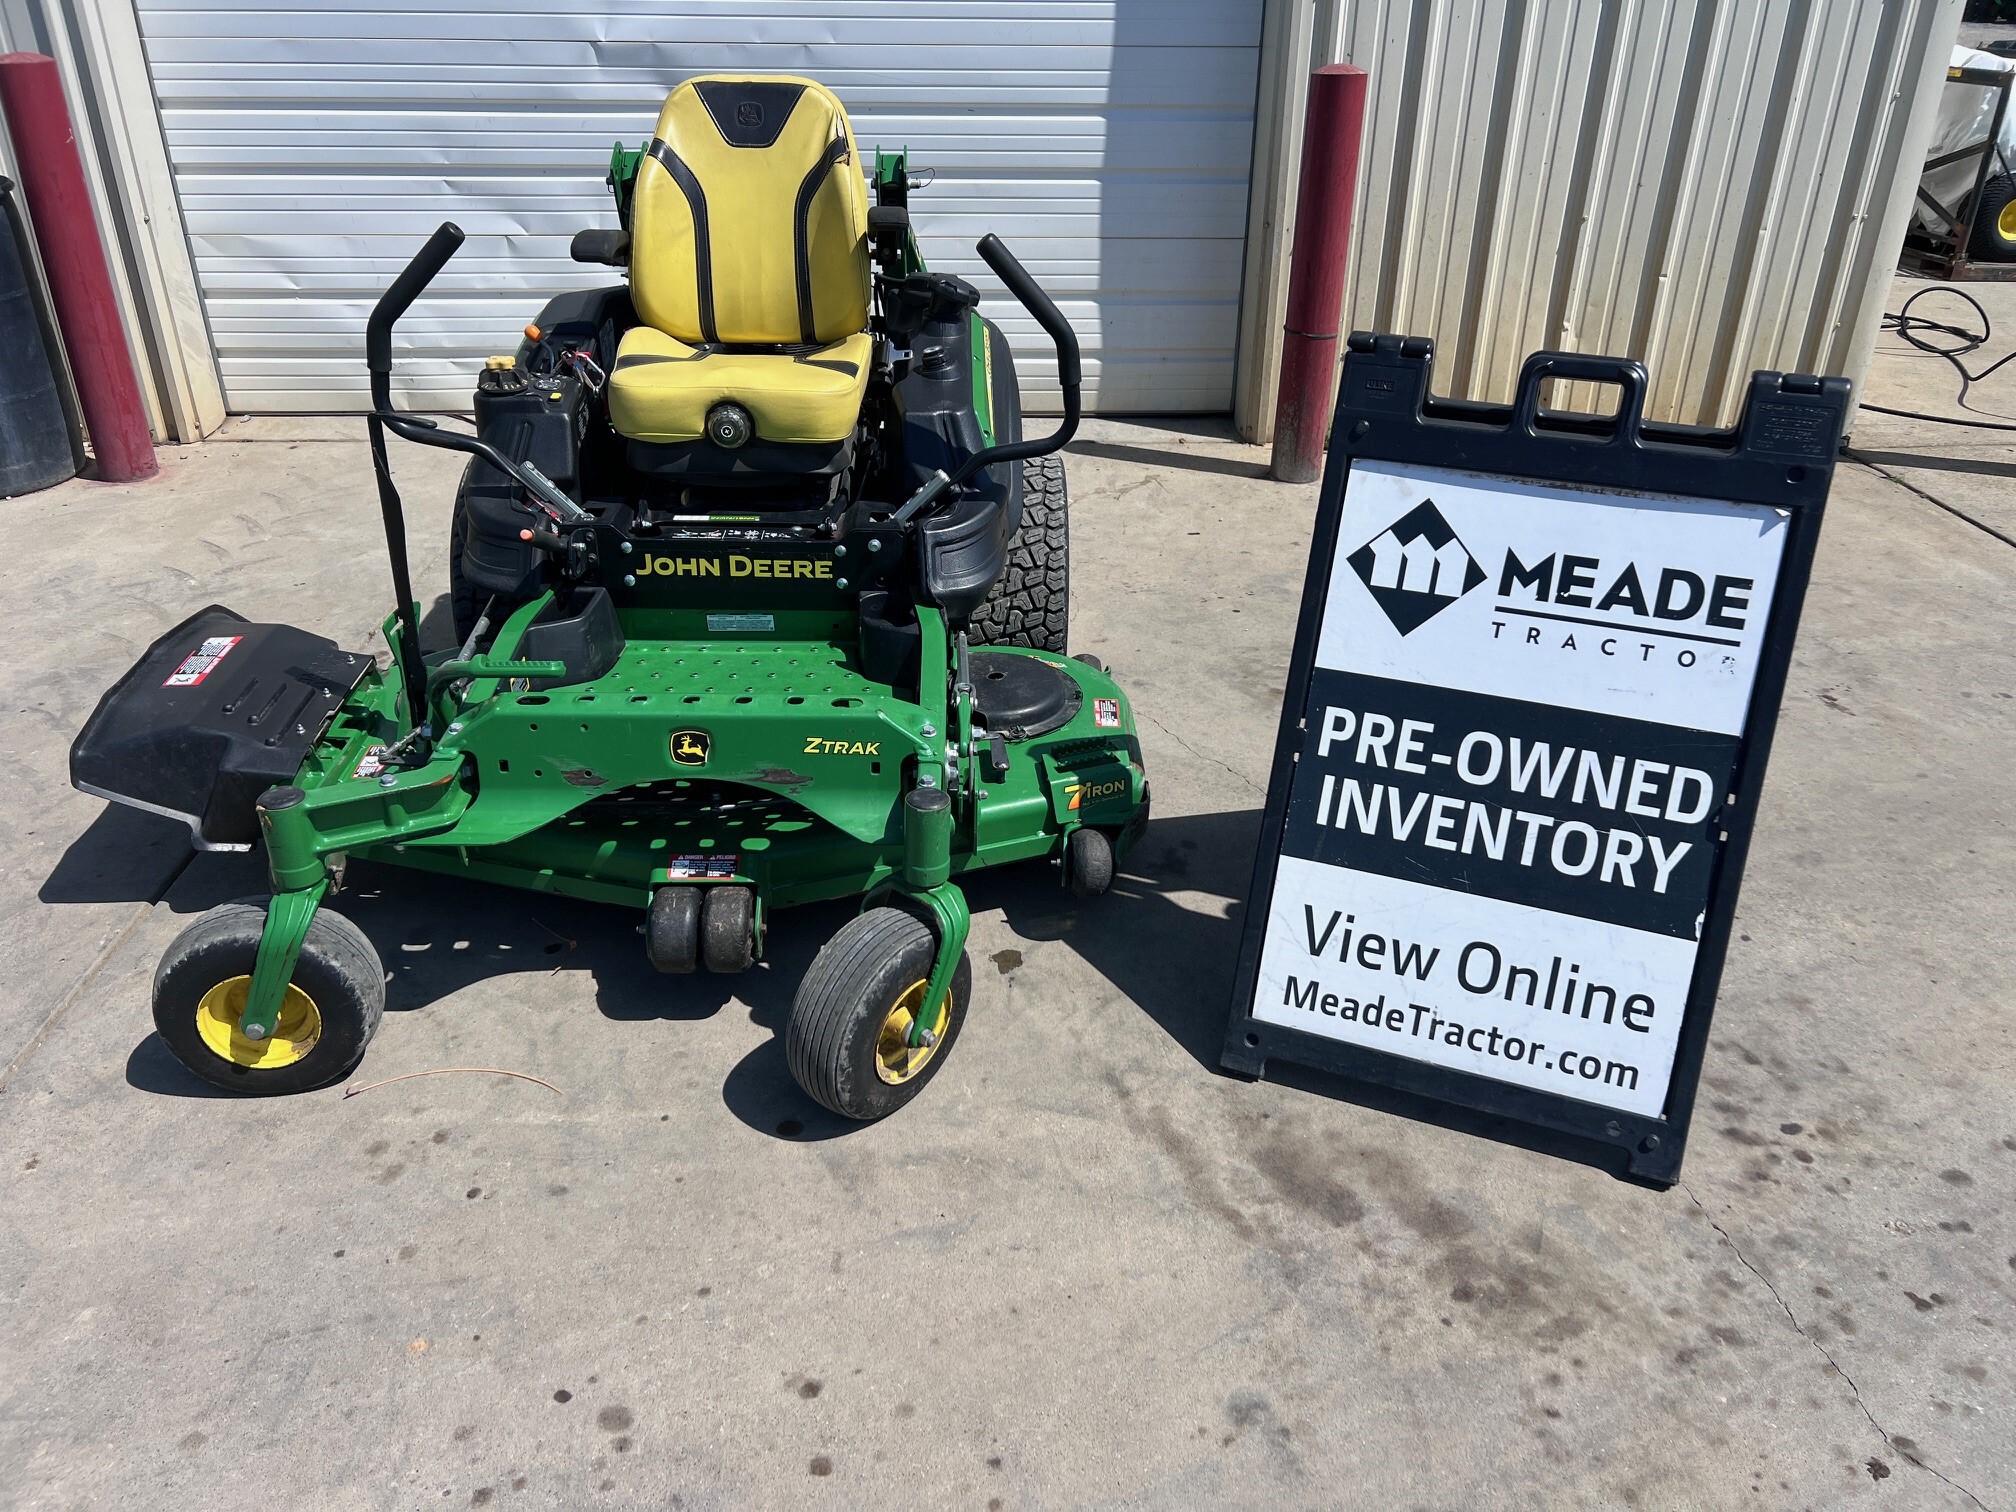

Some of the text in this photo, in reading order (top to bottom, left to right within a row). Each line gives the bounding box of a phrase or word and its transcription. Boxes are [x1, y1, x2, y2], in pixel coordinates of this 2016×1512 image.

[635, 553, 833, 579] JOHN DEERE
[1497, 546, 1754, 631] MEADE
[803, 737, 881, 755] ZTRAK
[1317, 705, 1714, 825] PRE-OWNED
[1316, 773, 1693, 895] INVENTORY
[1304, 904, 1655, 1033] View Online
[1283, 975, 1640, 1090] MeadeTractor.com
